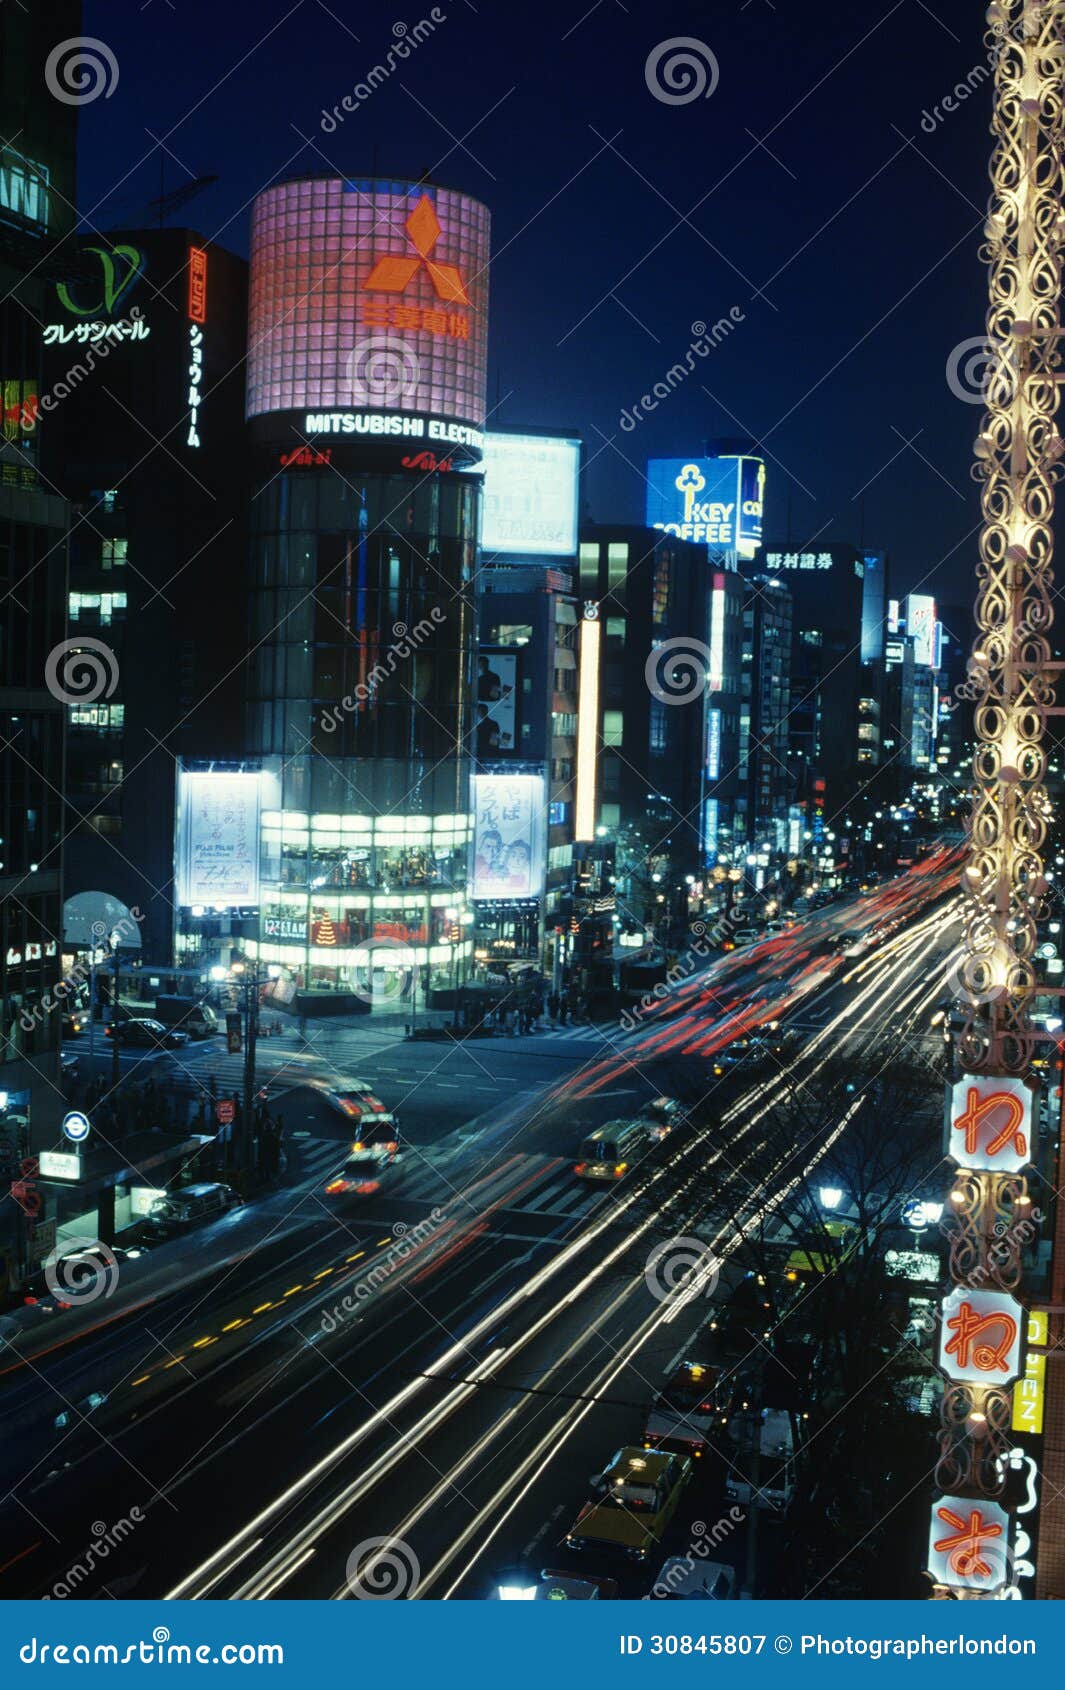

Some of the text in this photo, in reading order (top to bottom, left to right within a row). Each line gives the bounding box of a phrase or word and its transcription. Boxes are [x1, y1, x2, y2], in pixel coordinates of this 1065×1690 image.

[43, 321, 150, 345] クレサンベール
[362, 302, 470, 341] 三菱電機
[187, 324, 203, 448] ショウルーム
[306, 414, 424, 437] MITSUBISHI
[692, 503, 734, 522] KEY
[653, 523, 732, 543] OFFEE
